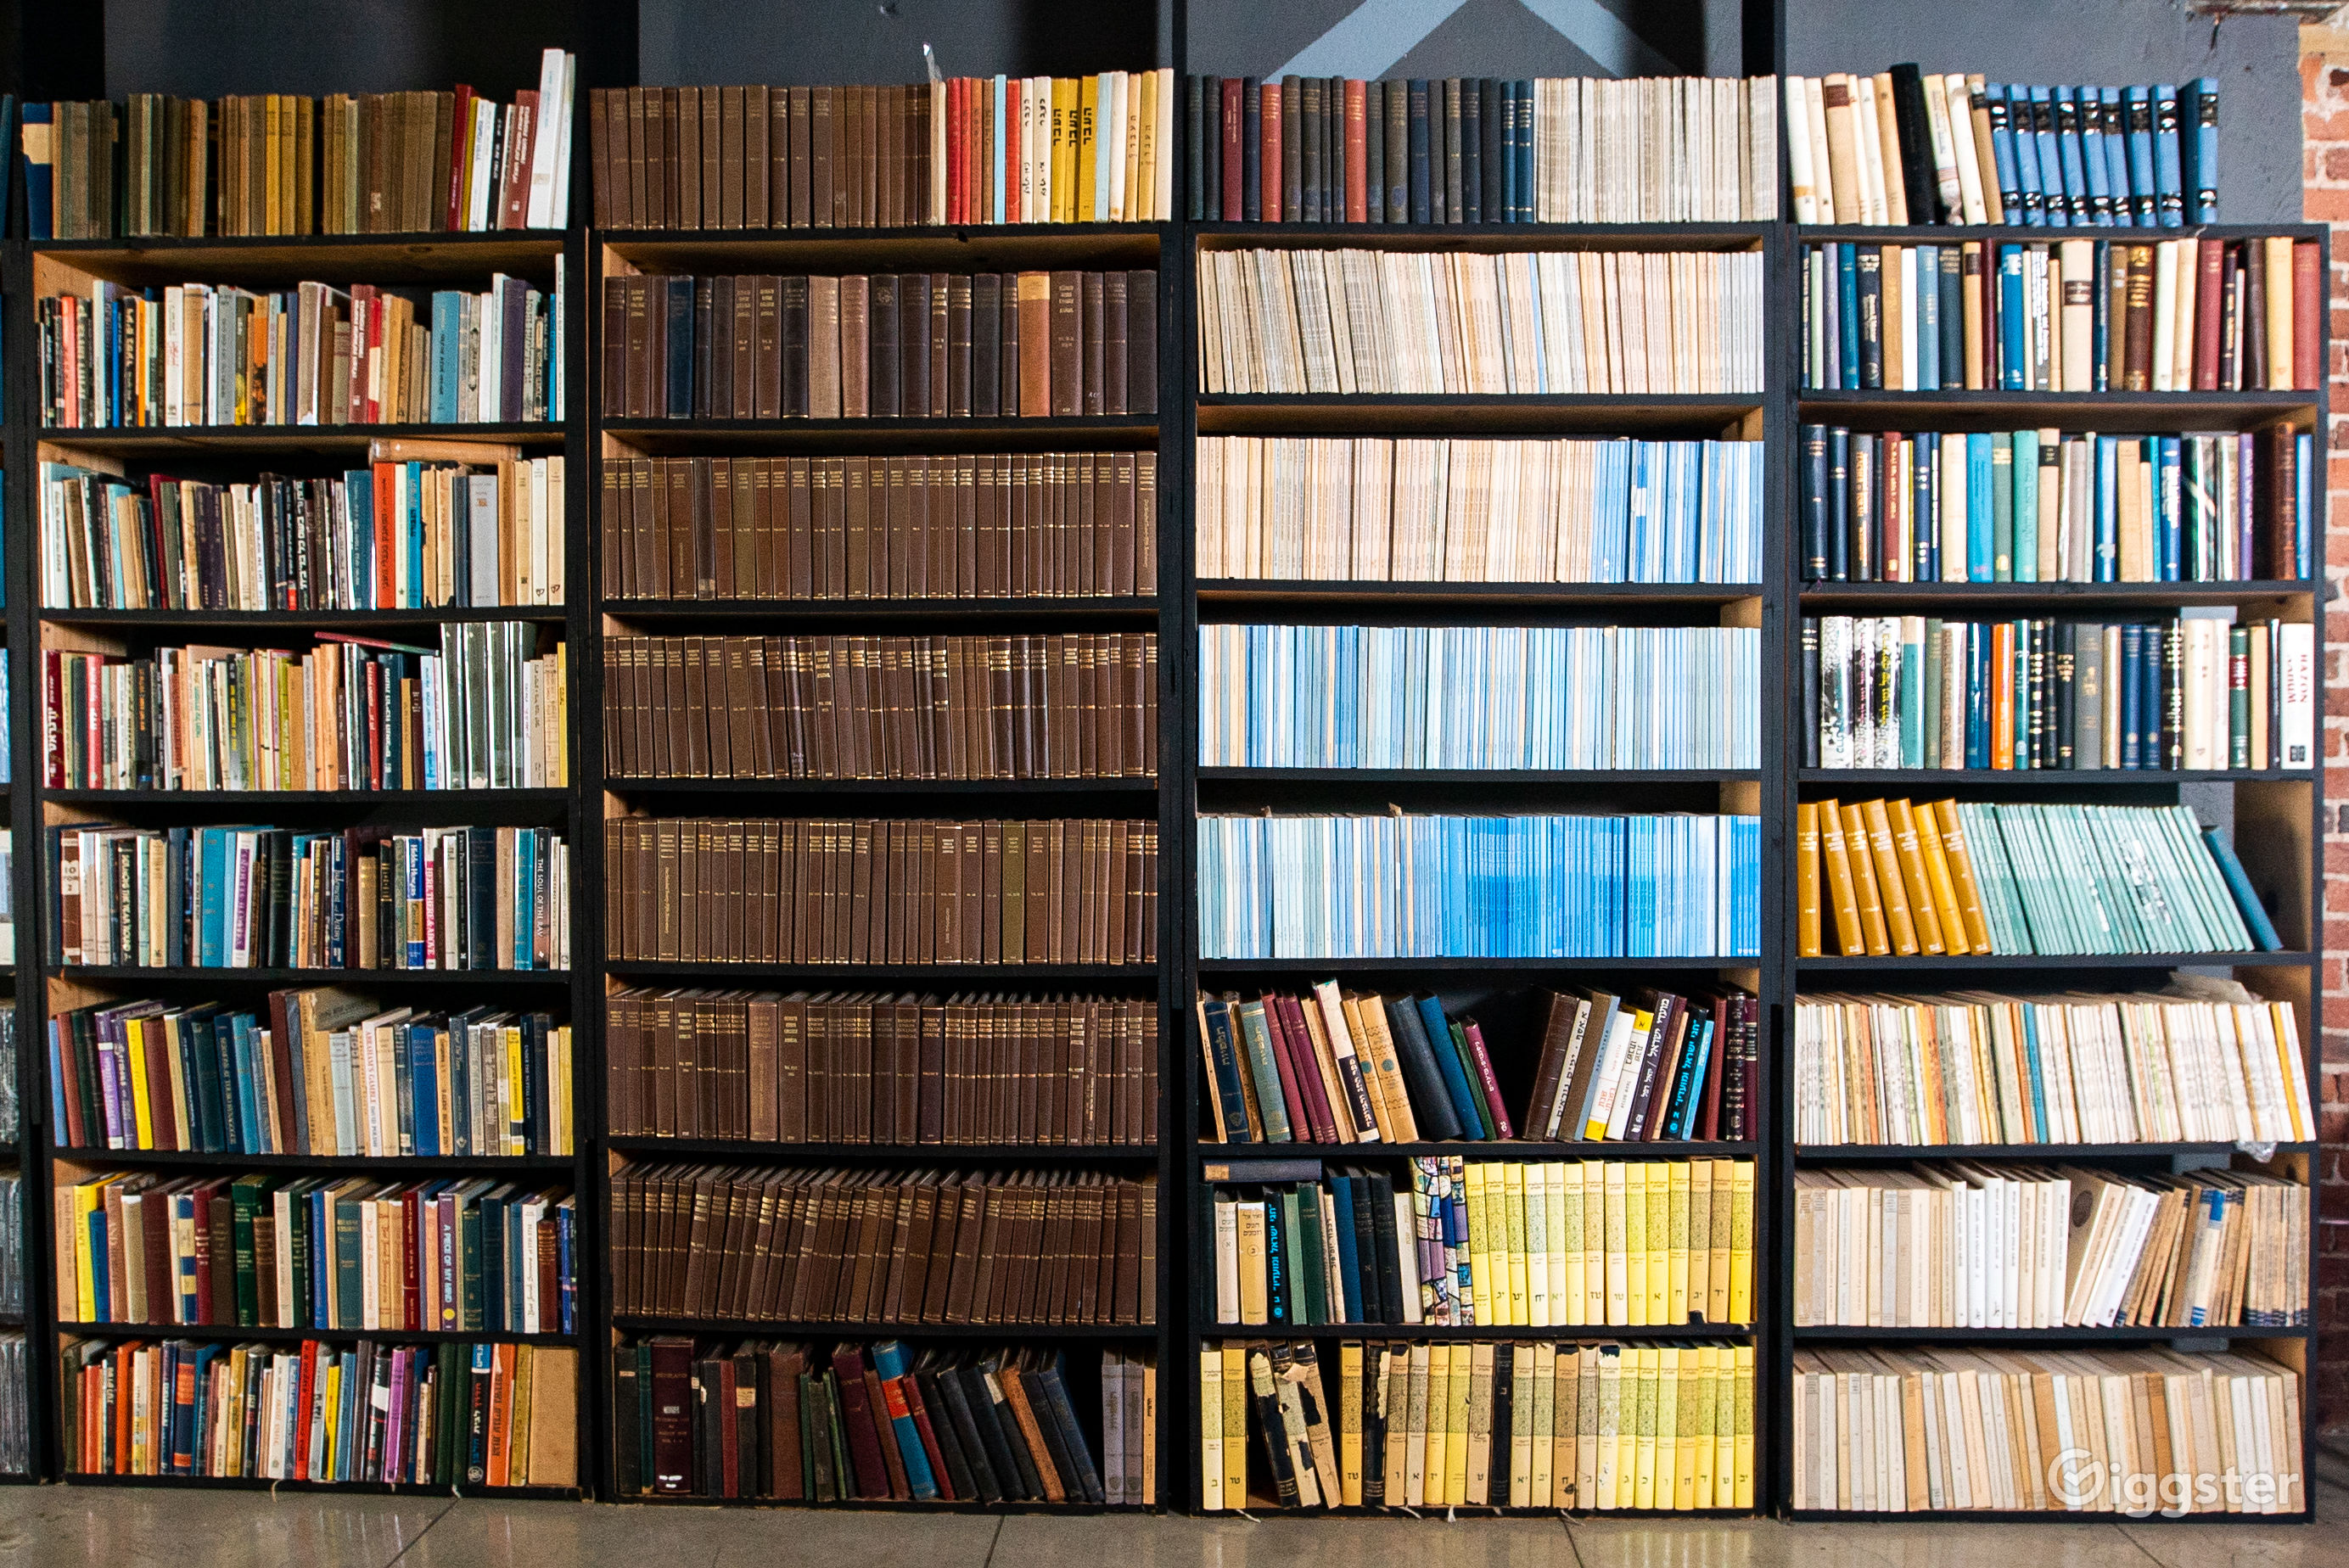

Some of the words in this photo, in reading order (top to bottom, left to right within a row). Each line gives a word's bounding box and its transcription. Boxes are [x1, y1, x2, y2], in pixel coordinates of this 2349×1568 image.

[1052, 109, 1062, 146] העבר
[1068, 109, 1079, 148] העבר
[1083, 107, 1092, 145] העבר
[297, 516, 306, 539] בשם
[297, 540, 306, 553] כל
[2300, 654, 2308, 703] HAZON
[48, 707, 58, 752] יודנראט
[334, 870, 345, 901] Judgement
[409, 868, 418, 895] Hungers
[332, 913, 345, 941] Destiny
[1656, 998, 1670, 1024] מועדי
[365, 1031, 373, 1072] ABRAHAM'S
[1215, 1027, 1230, 1066] תלפיות
[1254, 1026, 1268, 1066] תלפיות
[1625, 1040, 1636, 1065] בשבתו
[1634, 1045, 1644, 1062] שבת
[1647, 1028, 1661, 1057] ישראל
[1682, 1040, 1696, 1068] ישראל
[367, 1073, 376, 1104] GAMBLE
[1348, 1059, 1358, 1076] ספר
[1354, 1077, 1364, 1092] החג
[1359, 1095, 1372, 1128] והמועד
[227, 1103, 237, 1145] SYNAGOGUE
[1269, 1224, 1278, 1254] ישראל
[444, 1255, 451, 1266] OF
[445, 1268, 451, 1281] MY
[1511, 1292, 1522, 1301] יט
[1533, 1293, 1545, 1302] יח
[1652, 1292, 1661, 1301] א
[1674, 1289, 1682, 1297] ח
